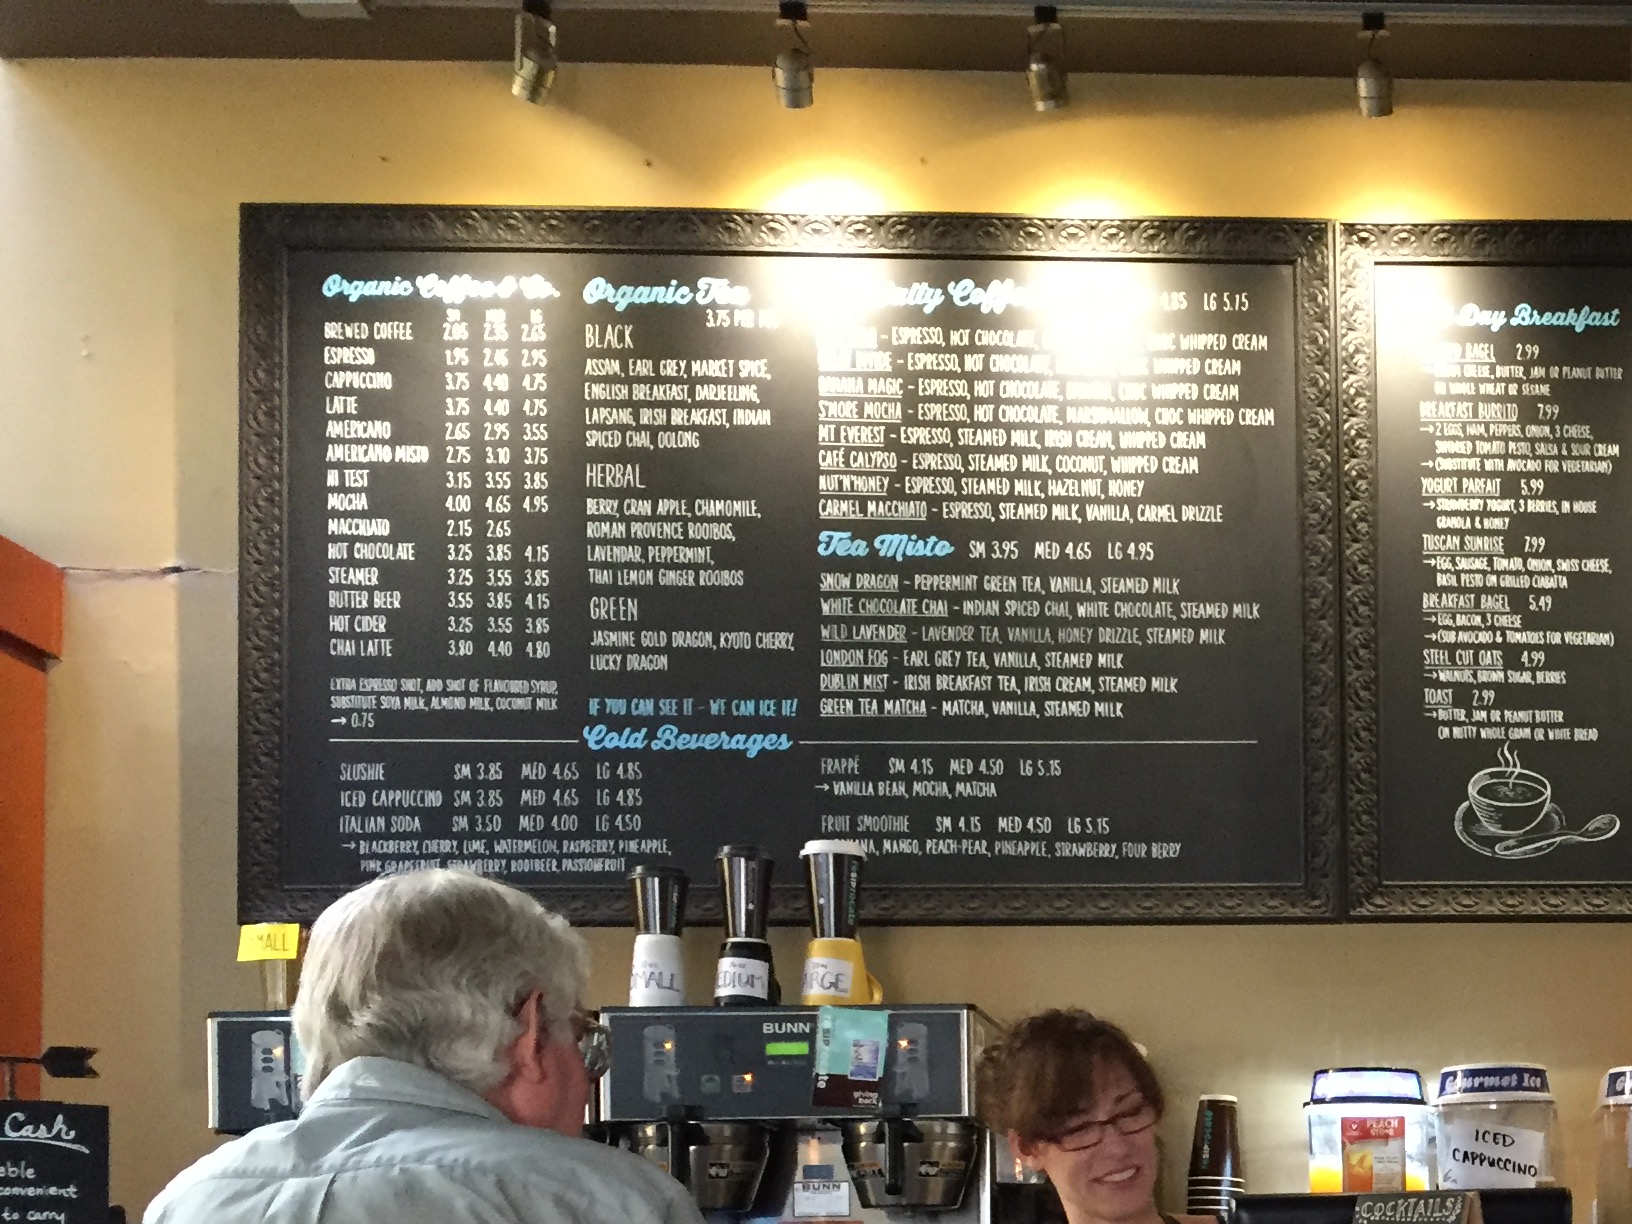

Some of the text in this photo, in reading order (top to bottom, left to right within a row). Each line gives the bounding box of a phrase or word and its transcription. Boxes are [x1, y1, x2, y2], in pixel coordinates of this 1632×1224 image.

[322, 274, 413, 302] Organic
[583, 278, 692, 311] Organic
[1457, 304, 1619, 332] Day Breakfast
[324, 322, 413, 340] BREWED COFFEE
[585, 325, 634, 349] BLACK
[324, 373, 392, 390] CAPPUCCINO
[326, 397, 357, 415] LATTE
[864, 402, 902, 419] MOCHA
[326, 421, 391, 439] AMERICANO
[819, 426, 884, 444] MT EVEREST
[819, 449, 897, 470] CAFÉ CALYPSO
[343, 470, 369, 487] TEST
[446, 471, 471, 488] 3.15
[485, 471, 511, 488] 3.55
[523, 471, 547, 489] 3.85
[586, 464, 645, 488] HERBAL
[1421, 477, 1544, 495] YOGURT PARFAIT 5.99
[328, 493, 548, 513] MOCHA 4.00 4.65 4.95
[328, 518, 389, 536] MACCHIATO
[328, 543, 415, 560] HOT CHOCOLATE
[817, 531, 1154, 561] Tea Misto SM 3.95 MED 4.65 LG 4.95
[329, 567, 378, 585] STEAMER
[329, 591, 400, 608] BUTTER BEER
[590, 598, 638, 621] GREEN
[329, 616, 386, 633] HOT CIDER
[330, 640, 393, 657] CHAI LATTE
[591, 630, 794, 651] JASMINE GOLD DRAGON, KYOTO CHERRY,
[590, 654, 668, 671] LUCKY DRAGON
[821, 651, 888, 667] LONDON FOG
[1424, 650, 1545, 667] STEEL CUT OATS 4.99
[1424, 689, 1495, 706] TOAST 2.99
[820, 700, 927, 717] GREEN TEA MATCHA
[583, 724, 792, 757] Cold Beverages
[340, 763, 385, 781] SLUSHIE
[341, 790, 442, 807] ICED CAPPUCCINO
[822, 816, 910, 833] FRUIT SMOOTHIE
[763, 1022, 810, 1033] BUNN
[1522, 1074, 1541, 1087] Ice
[4, 1112, 75, 1139] Cash
[1475, 1129, 1515, 1147] ICED
[1452, 1148, 1537, 1177] CAPPUCCINO
[802, 1183, 841, 1191] BUNN
[1361, 1197, 1455, 1221] COCKTAILS
